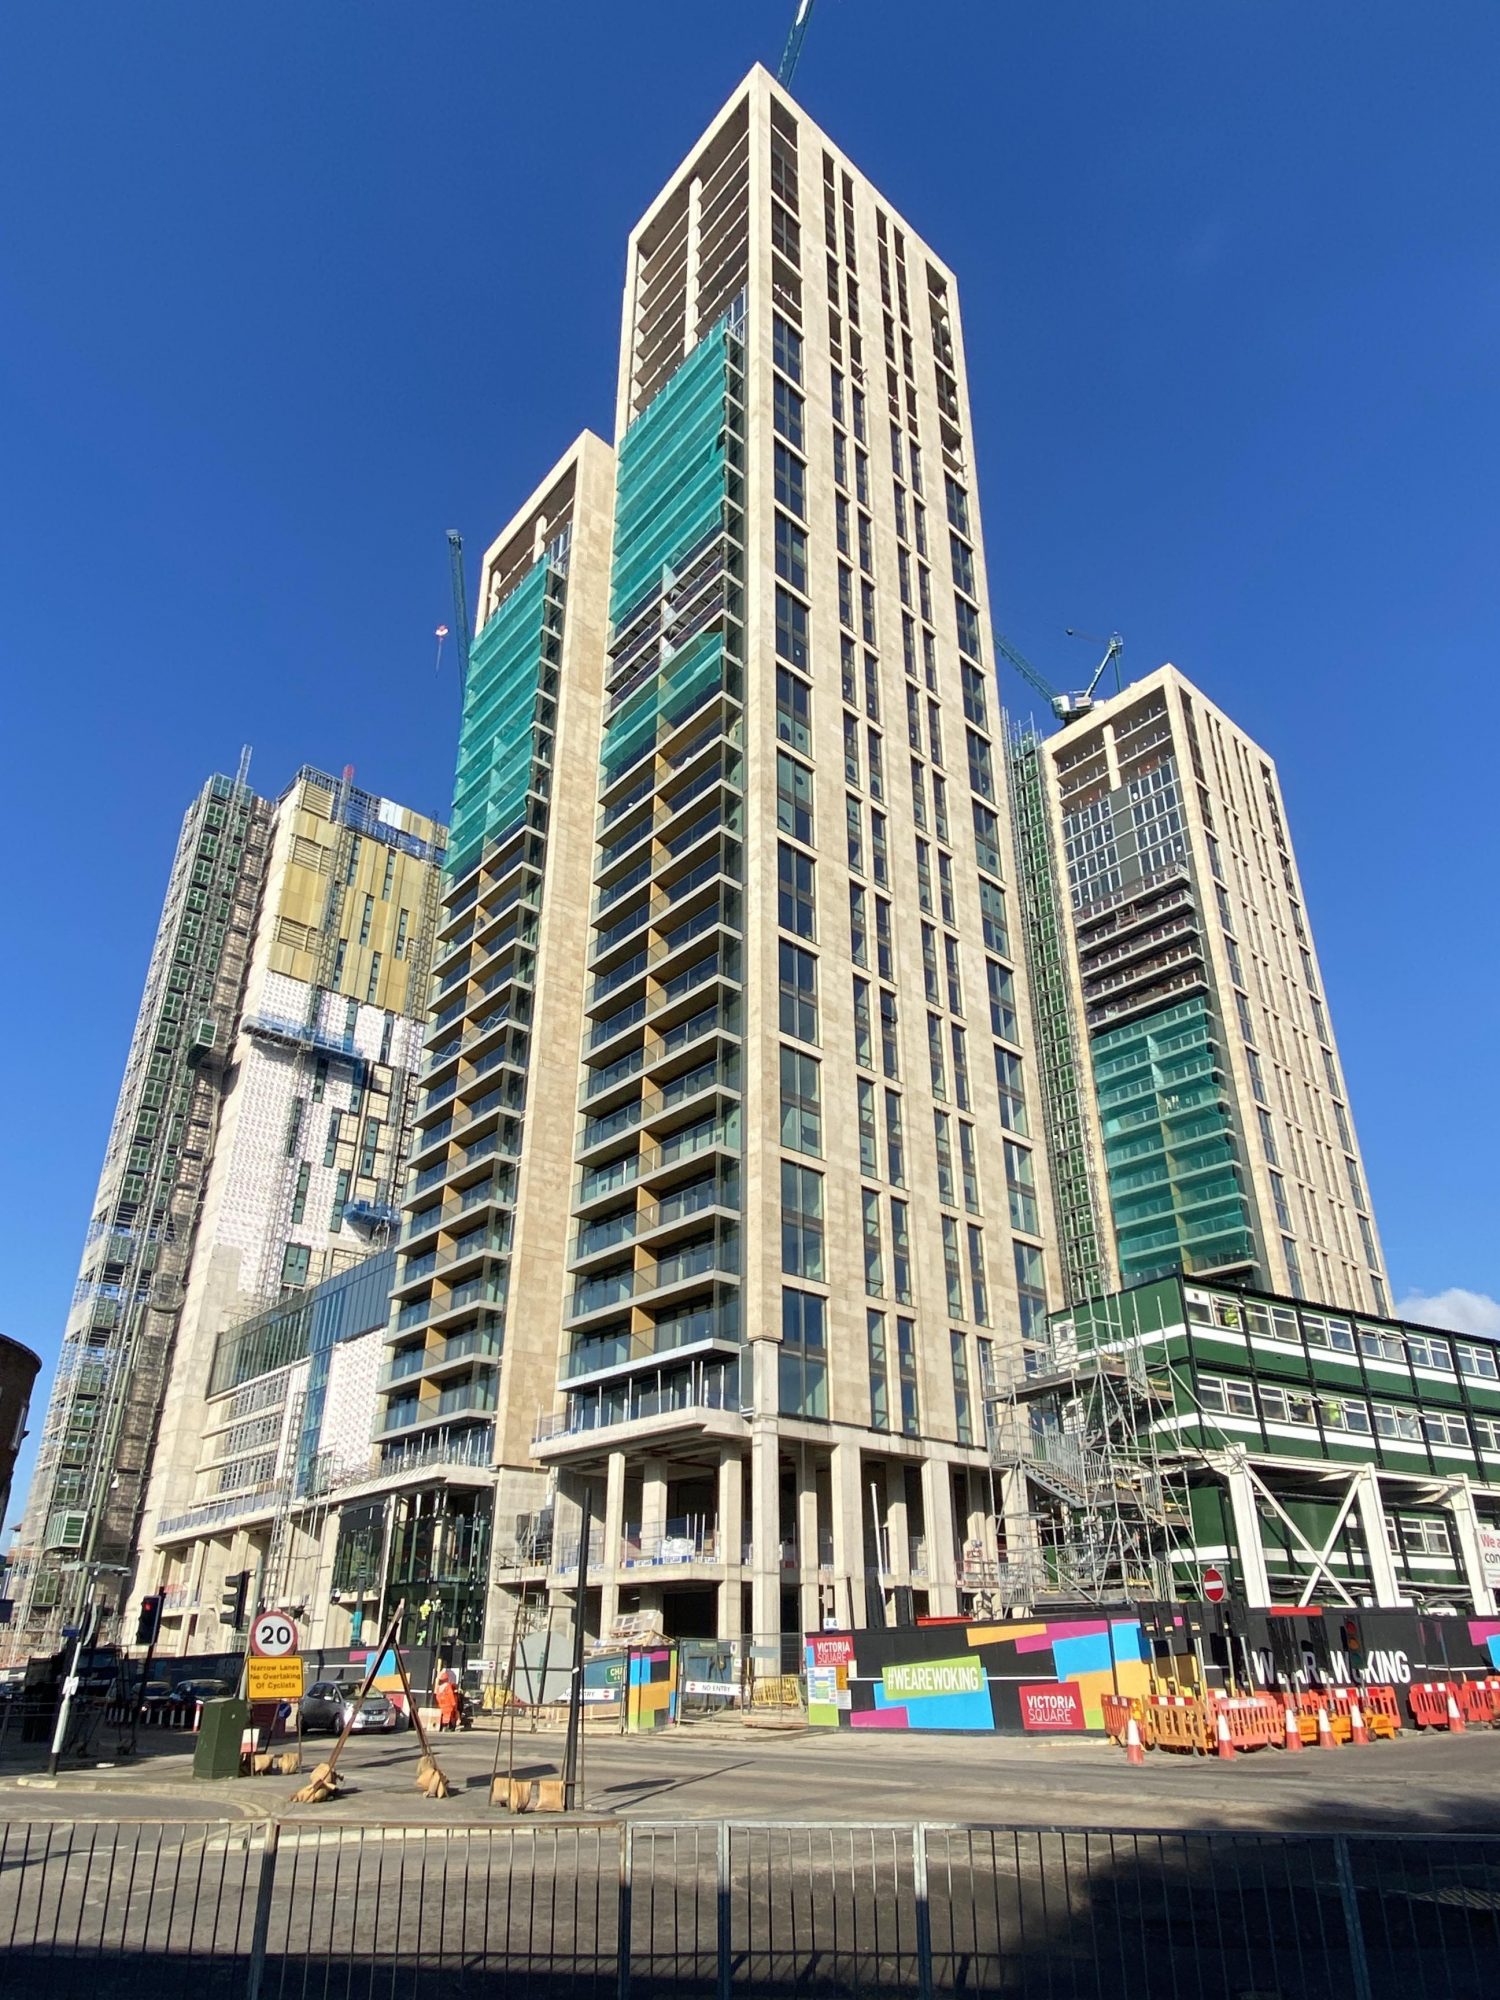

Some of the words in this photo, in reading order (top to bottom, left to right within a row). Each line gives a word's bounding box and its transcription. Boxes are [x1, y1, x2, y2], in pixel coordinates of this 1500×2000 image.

[1480, 1534, 1495, 1548] We
[261, 1625, 291, 1645] 20
[817, 1641, 850, 1653] VICTORIA
[817, 1652, 847, 1664] SQUARE
[267, 1681, 296, 1690] Cyclists
[887, 1666, 979, 1691] #WEAREWOKING
[712, 1684, 731, 1692] ENTRY
[1026, 1695, 1076, 1710] VICTORIA
[1029, 1709, 1072, 1723] SQUARE
